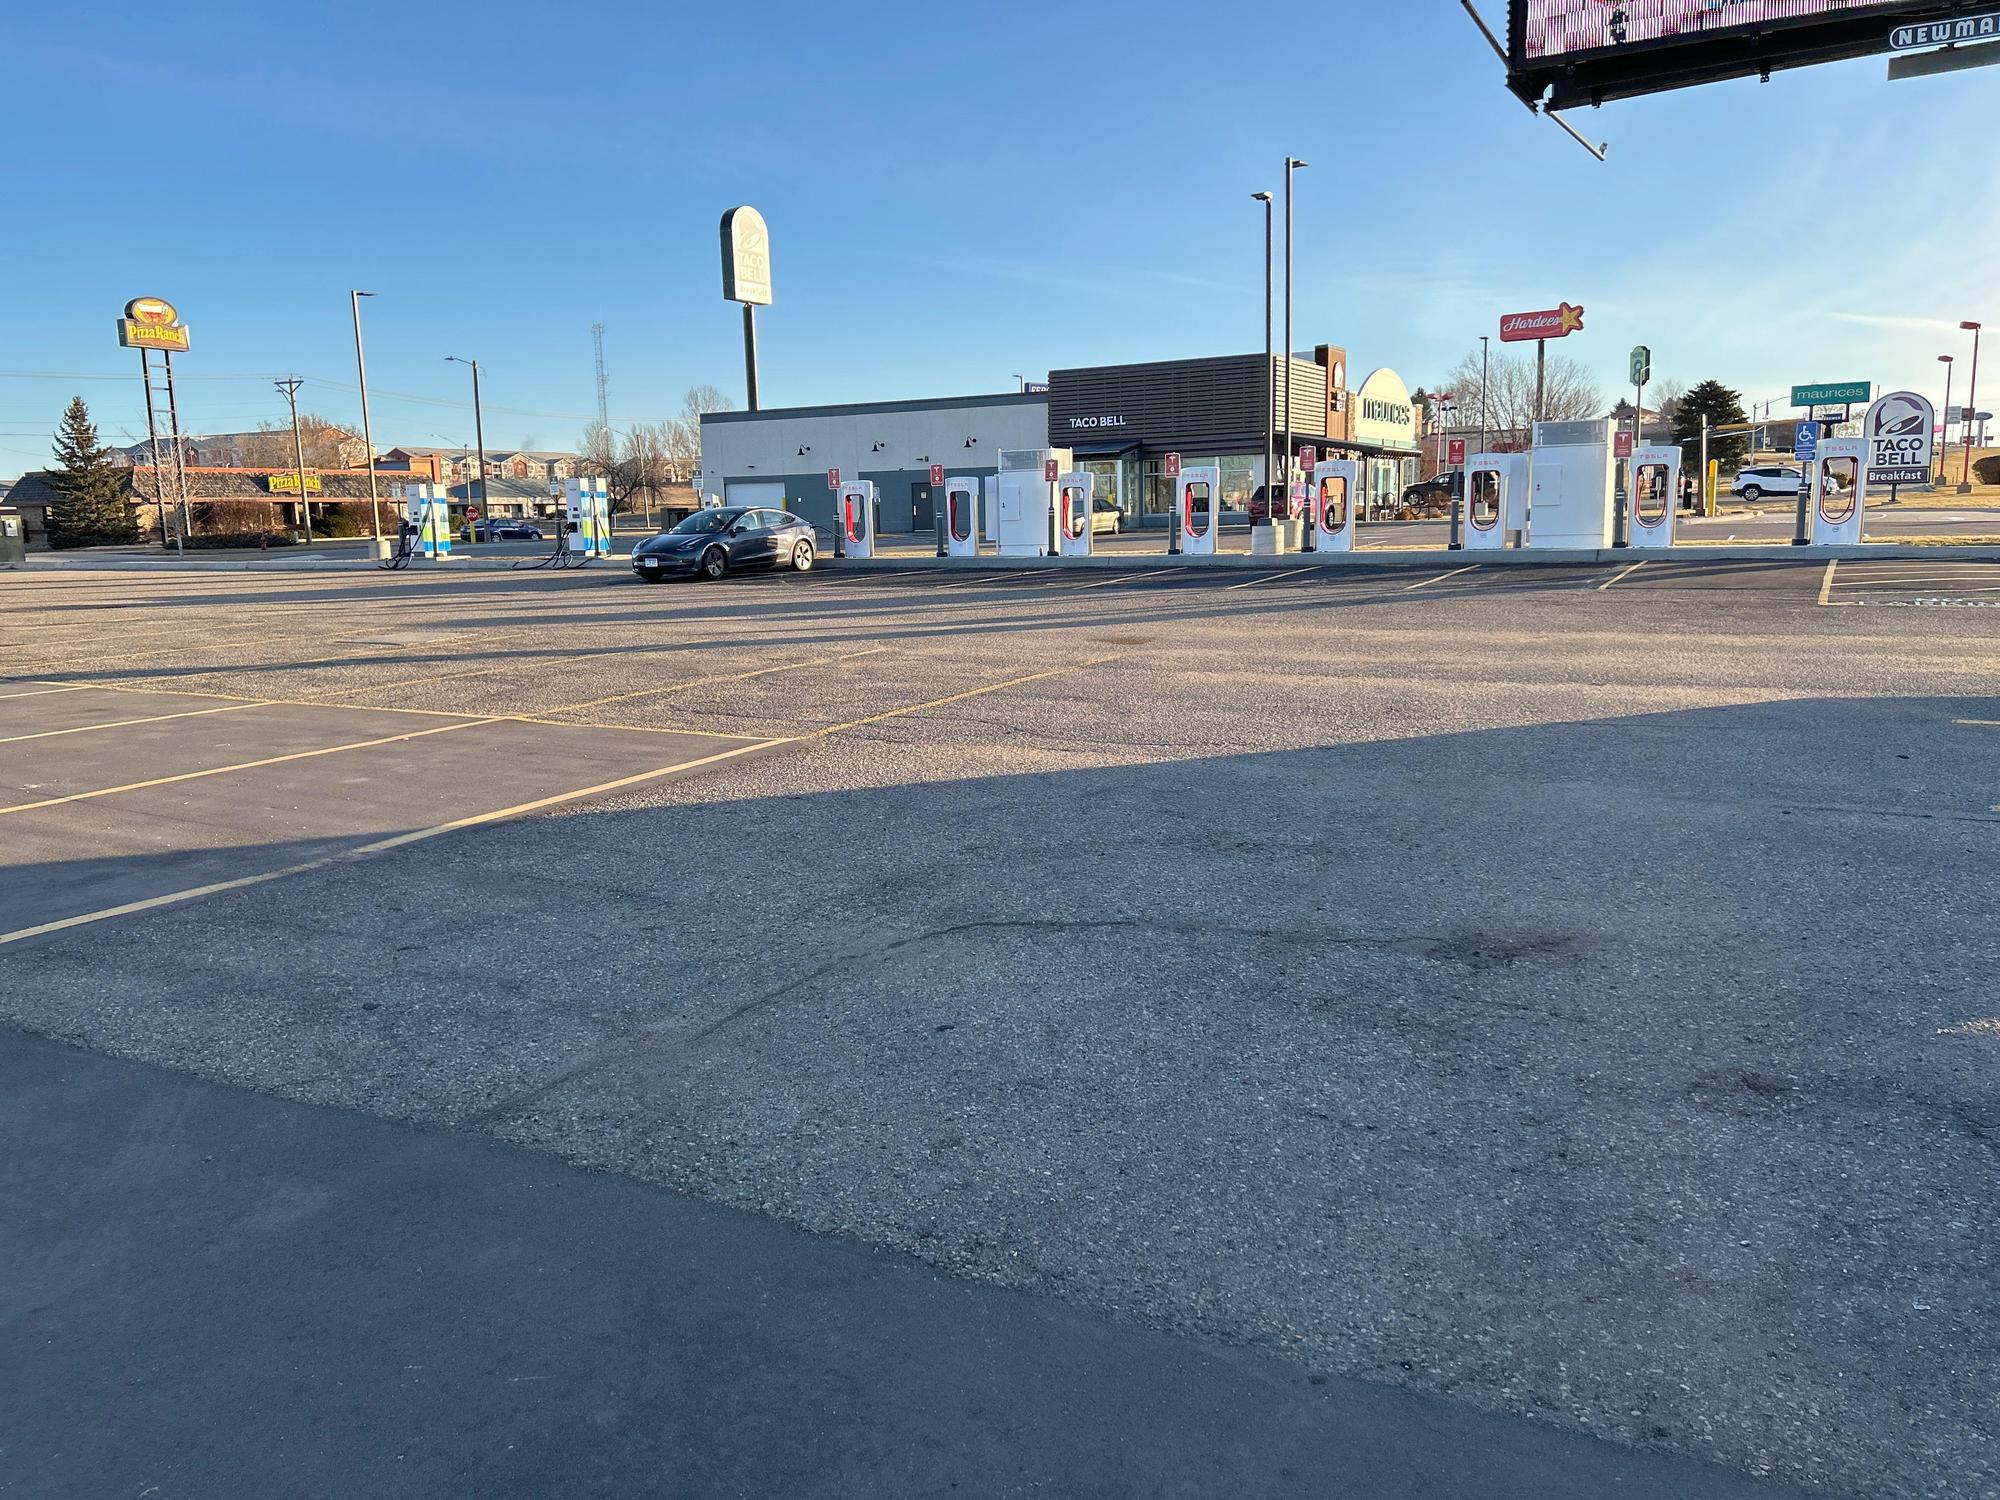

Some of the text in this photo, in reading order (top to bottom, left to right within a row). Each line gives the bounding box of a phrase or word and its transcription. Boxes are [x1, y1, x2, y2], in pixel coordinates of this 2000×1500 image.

[1898, 17, 2000, 45] NEWMA
[738, 253, 764, 268] TACO
[740, 267, 766, 282] BELL
[128, 325, 187, 345] Pizza Ranch
[1797, 387, 1864, 399] maurices
[1069, 415, 1127, 428] TACO BELL
[1873, 438, 1924, 452] TACO
[1876, 452, 1922, 465] BELL
[269, 474, 321, 490] Pizza Rnch
[1869, 471, 1922, 481] Breakfast
